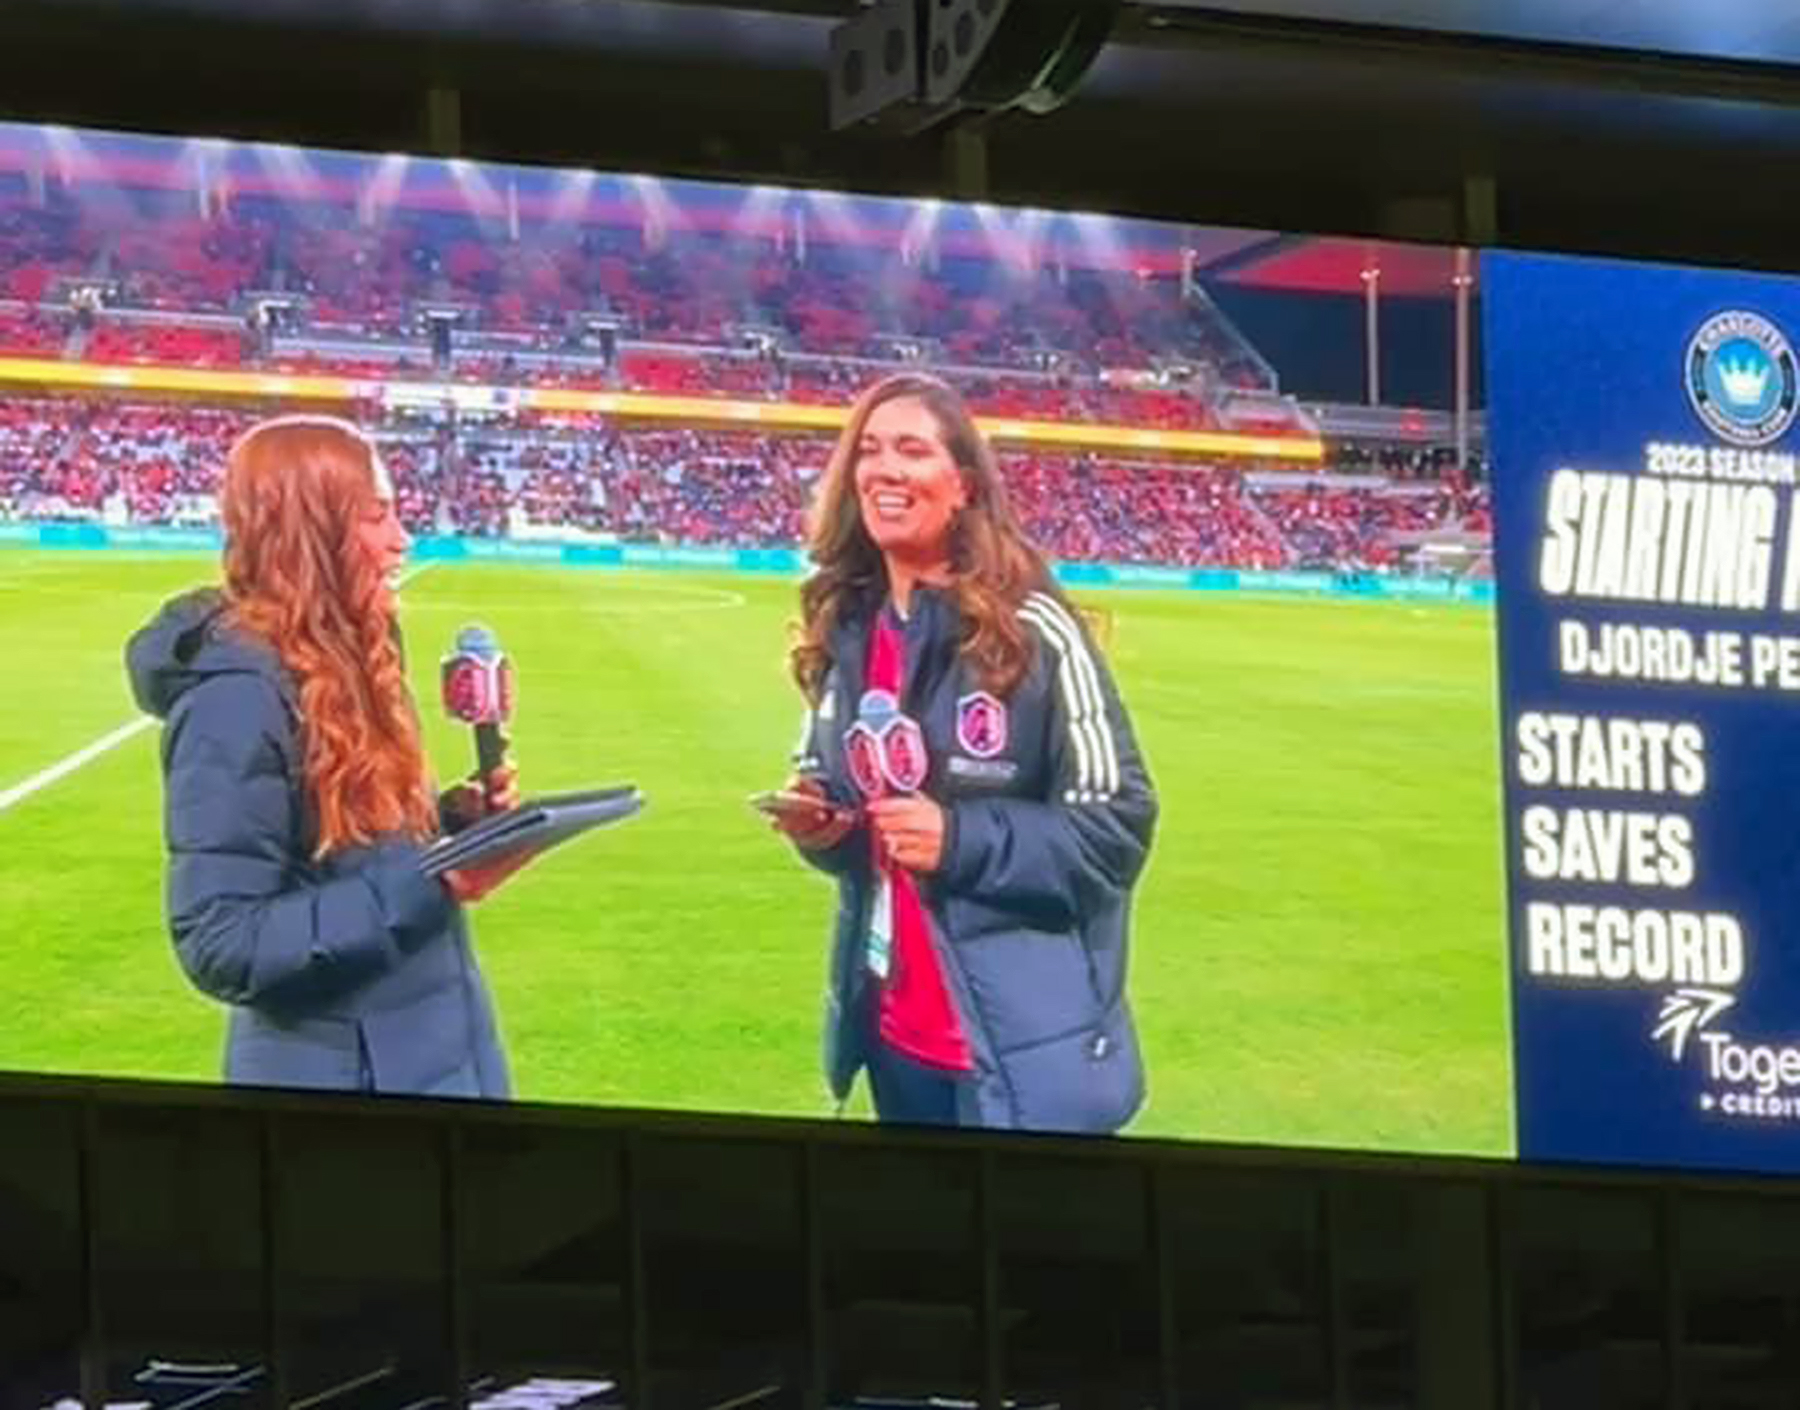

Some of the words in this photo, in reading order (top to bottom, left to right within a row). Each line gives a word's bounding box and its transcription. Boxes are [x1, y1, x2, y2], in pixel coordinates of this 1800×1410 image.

[1646, 442, 1704, 475] 2023
[1709, 448, 1795, 483] SEASON
[1541, 469, 1776, 609] STARTING
[1560, 620, 1743, 686] DJORDJE
[1518, 712, 1705, 795] STARTS
[1523, 805, 1694, 887] SAVES
[1528, 902, 1744, 985] RECORD
